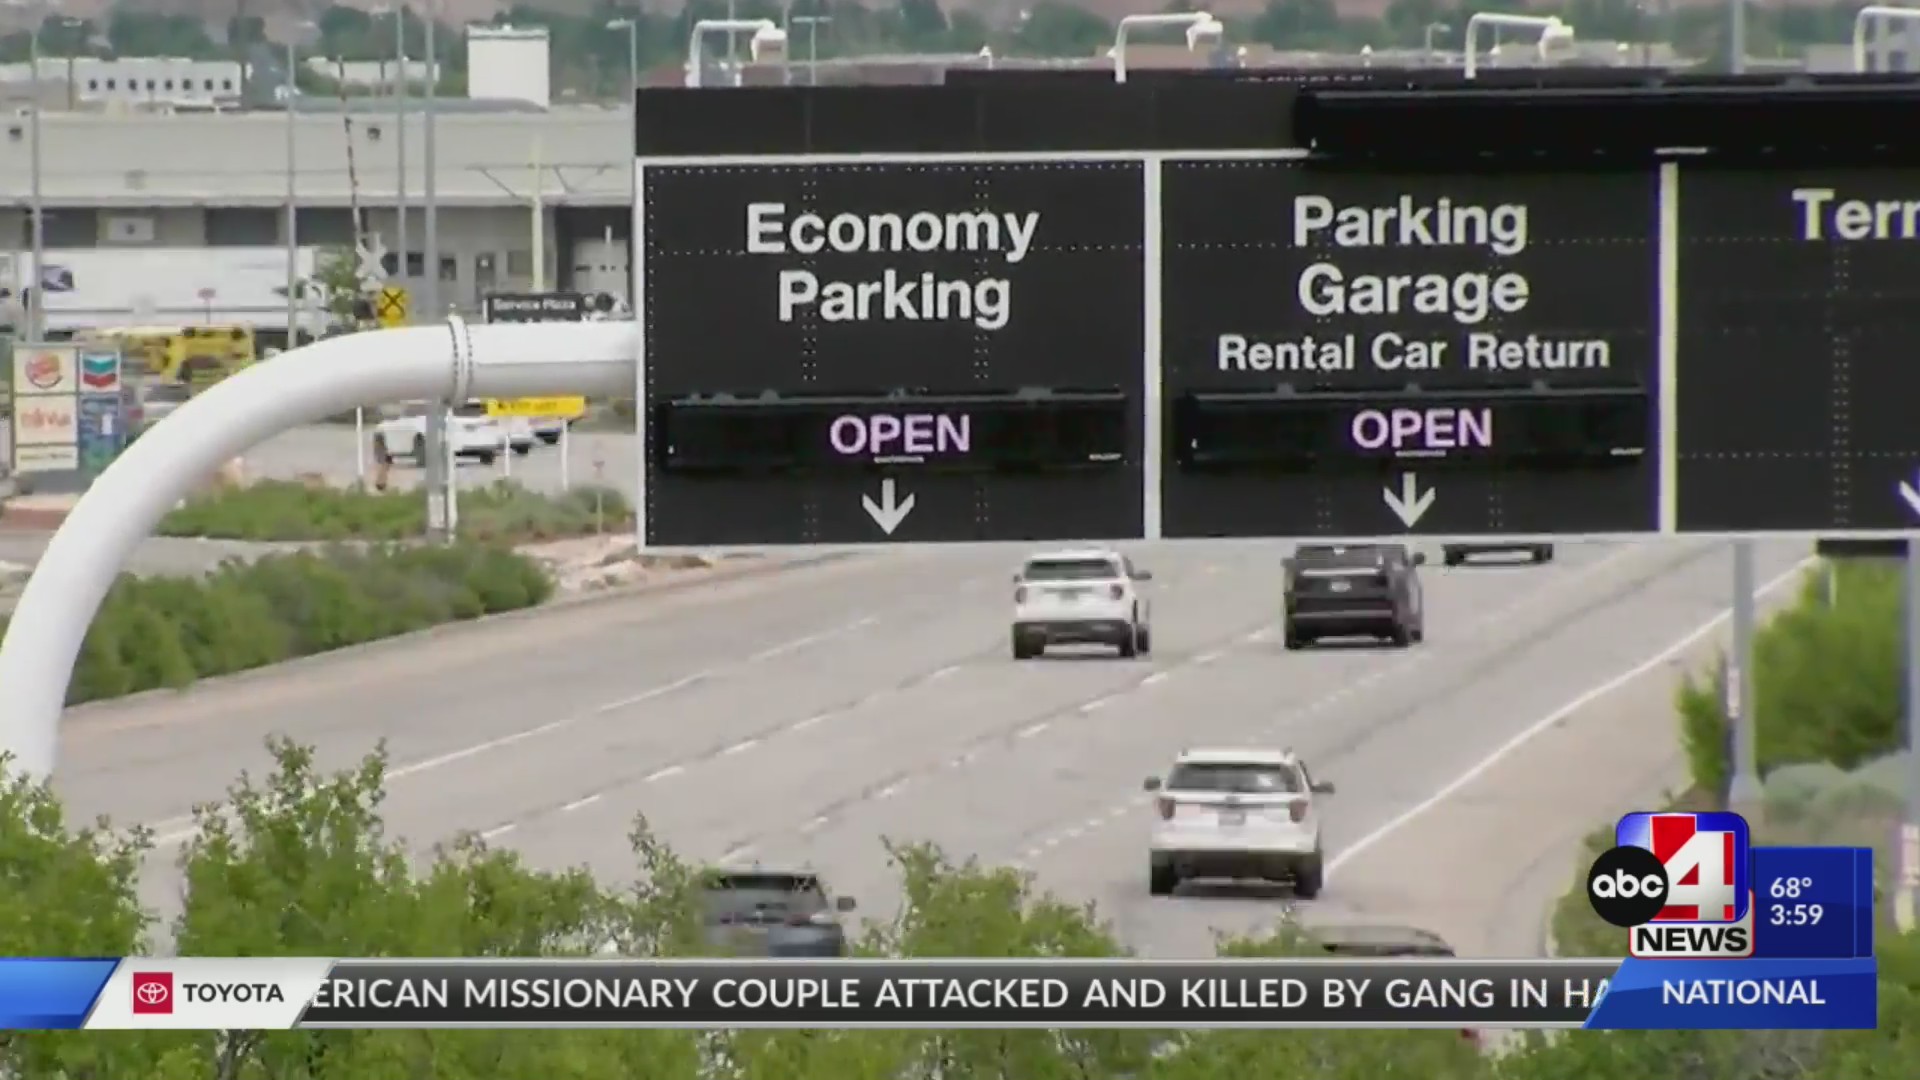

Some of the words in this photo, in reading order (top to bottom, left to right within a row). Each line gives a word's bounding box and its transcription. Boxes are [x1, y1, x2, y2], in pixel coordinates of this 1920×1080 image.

[746, 202, 1040, 263] Economy
[1293, 195, 1528, 255] Parking
[778, 269, 1011, 330] Parking
[1298, 263, 1530, 324] Garage
[1218, 333, 1354, 371] Rental
[1371, 332, 1448, 370] Car
[1468, 333, 1610, 369] Return
[829, 414, 970, 454] OPEN
[1351, 408, 1493, 448] OPEN
